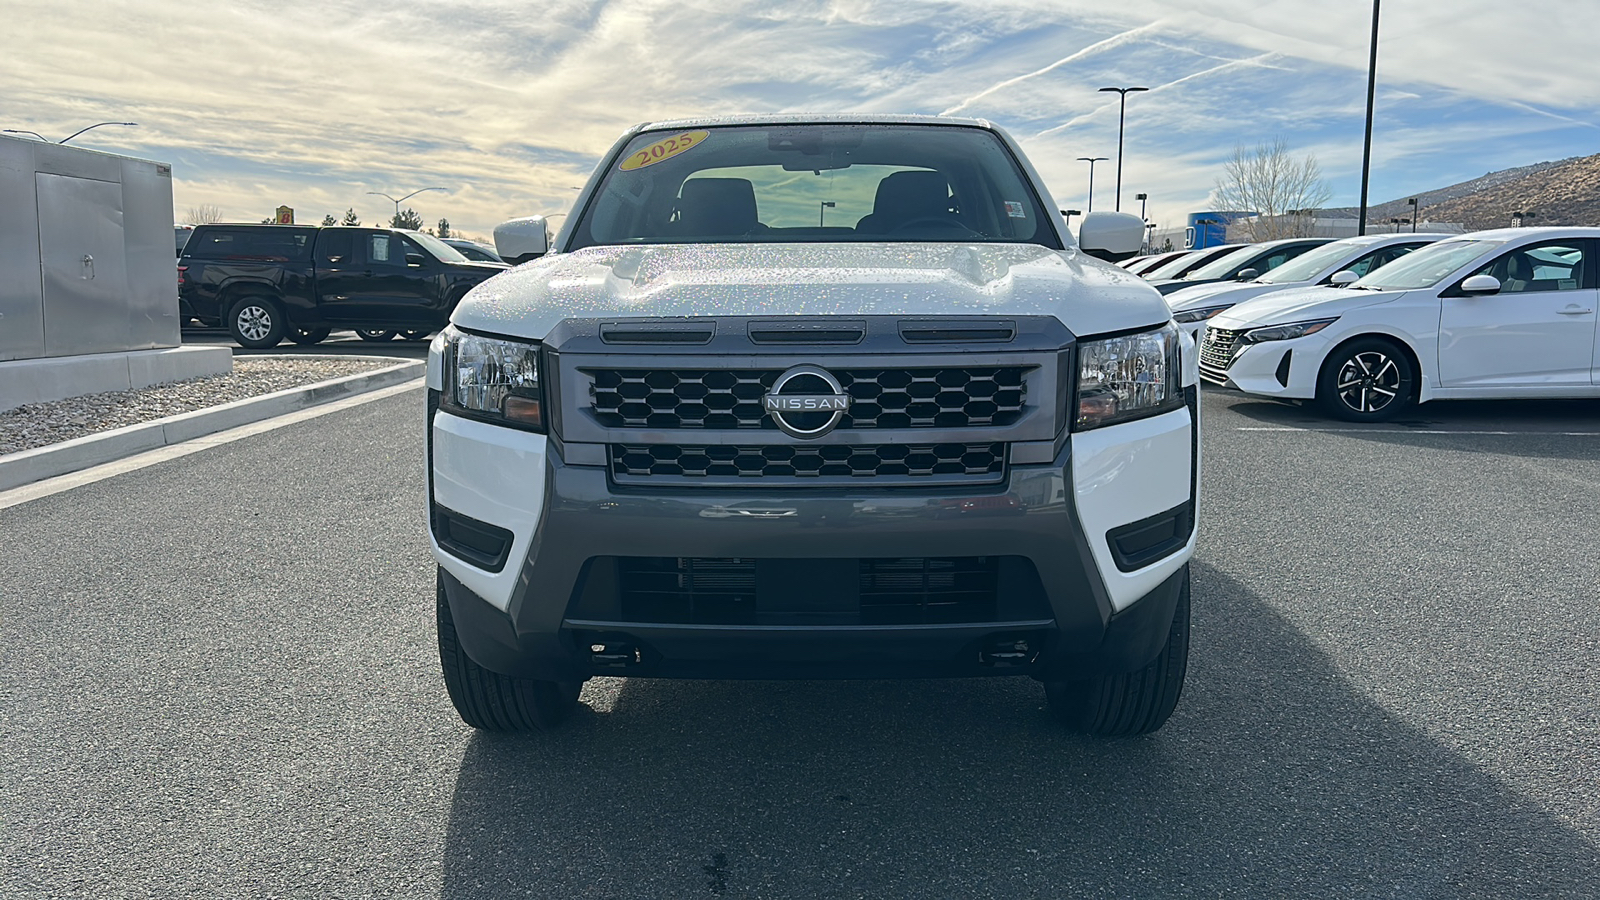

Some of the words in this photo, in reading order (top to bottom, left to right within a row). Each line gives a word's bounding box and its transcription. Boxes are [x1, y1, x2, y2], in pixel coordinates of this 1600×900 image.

[637, 133, 692, 165] 2025
[281, 213, 291, 224] 8
[767, 398, 847, 409] NISSAN
